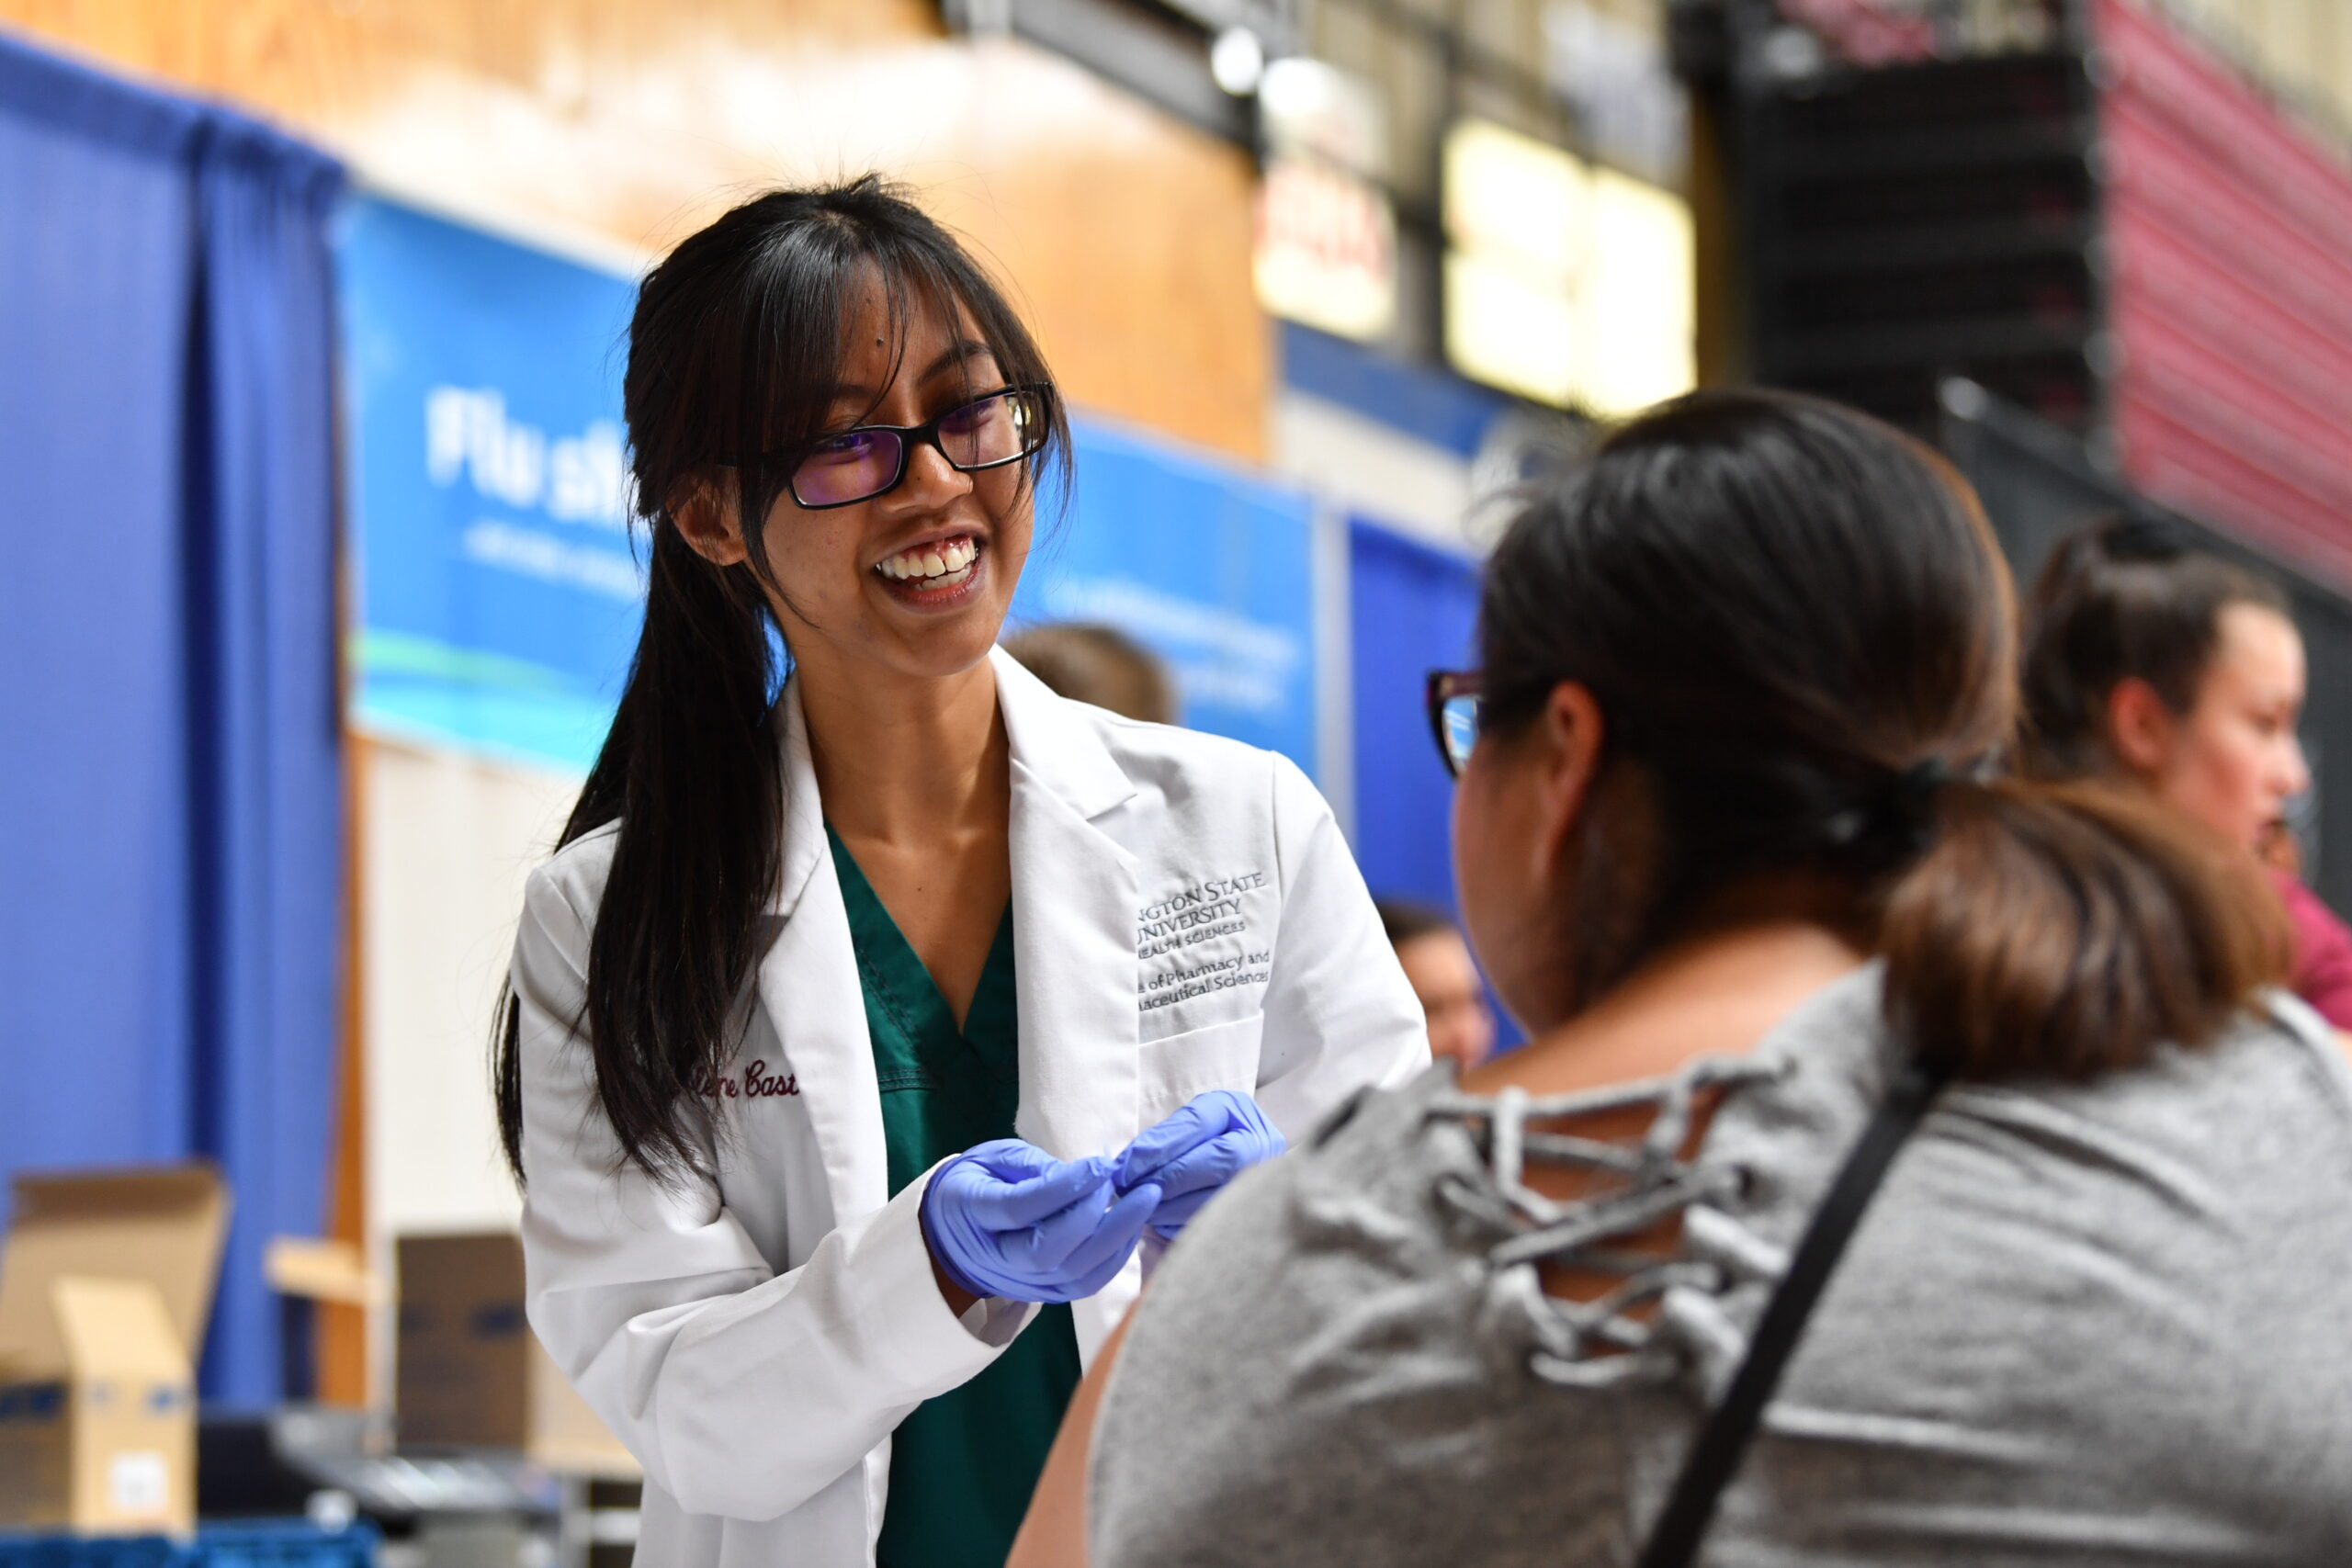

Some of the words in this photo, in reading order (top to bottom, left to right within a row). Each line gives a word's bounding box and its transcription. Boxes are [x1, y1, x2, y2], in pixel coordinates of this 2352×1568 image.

[1184, 921, 1246, 945] SCIENCES
[1148, 974, 1164, 991] of
[1166, 956, 1243, 986] Pharmacy
[1248, 950, 1270, 964] and
[1214, 970, 1269, 990] Sciences
[745, 1059, 799, 1098] Cast
